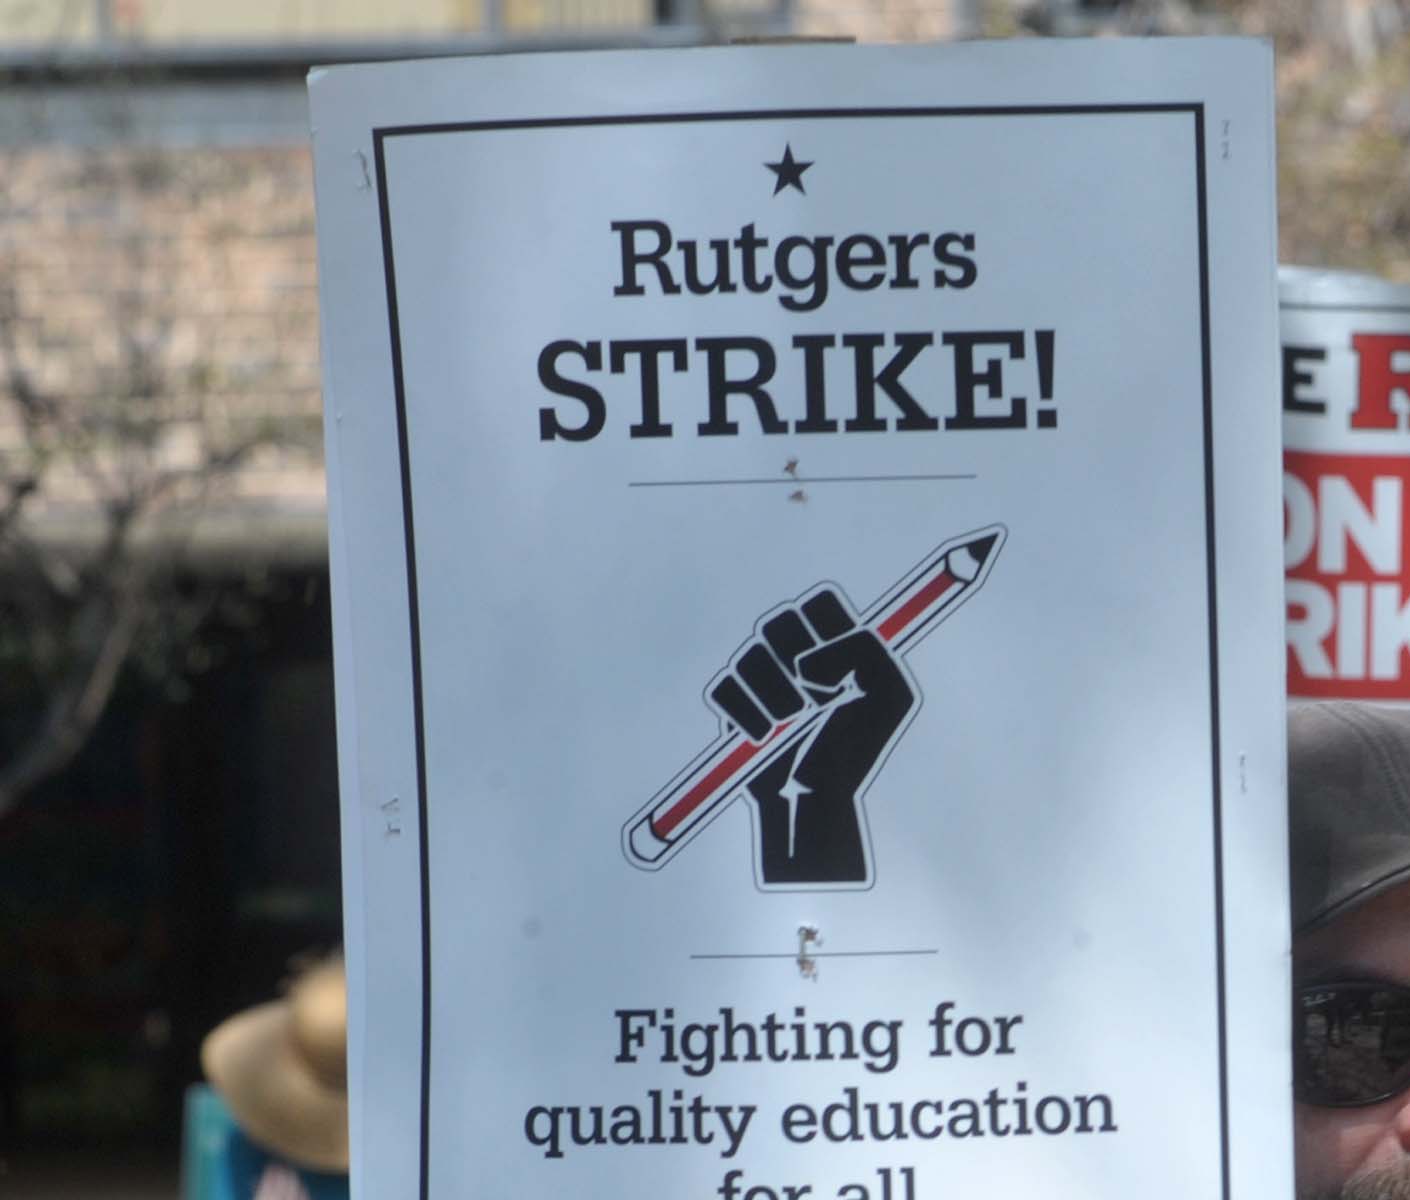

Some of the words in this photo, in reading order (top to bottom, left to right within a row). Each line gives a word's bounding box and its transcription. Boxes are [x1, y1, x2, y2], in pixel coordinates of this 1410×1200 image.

[611, 220, 978, 313] Rutgers
[537, 329, 1059, 443] STRIKE!
[1284, 344, 1327, 416] E
[613, 1007, 903, 1077] Fighting
[928, 1001, 1023, 1058] for
[524, 1089, 757, 1159] quality
[781, 1081, 1118, 1144] education
